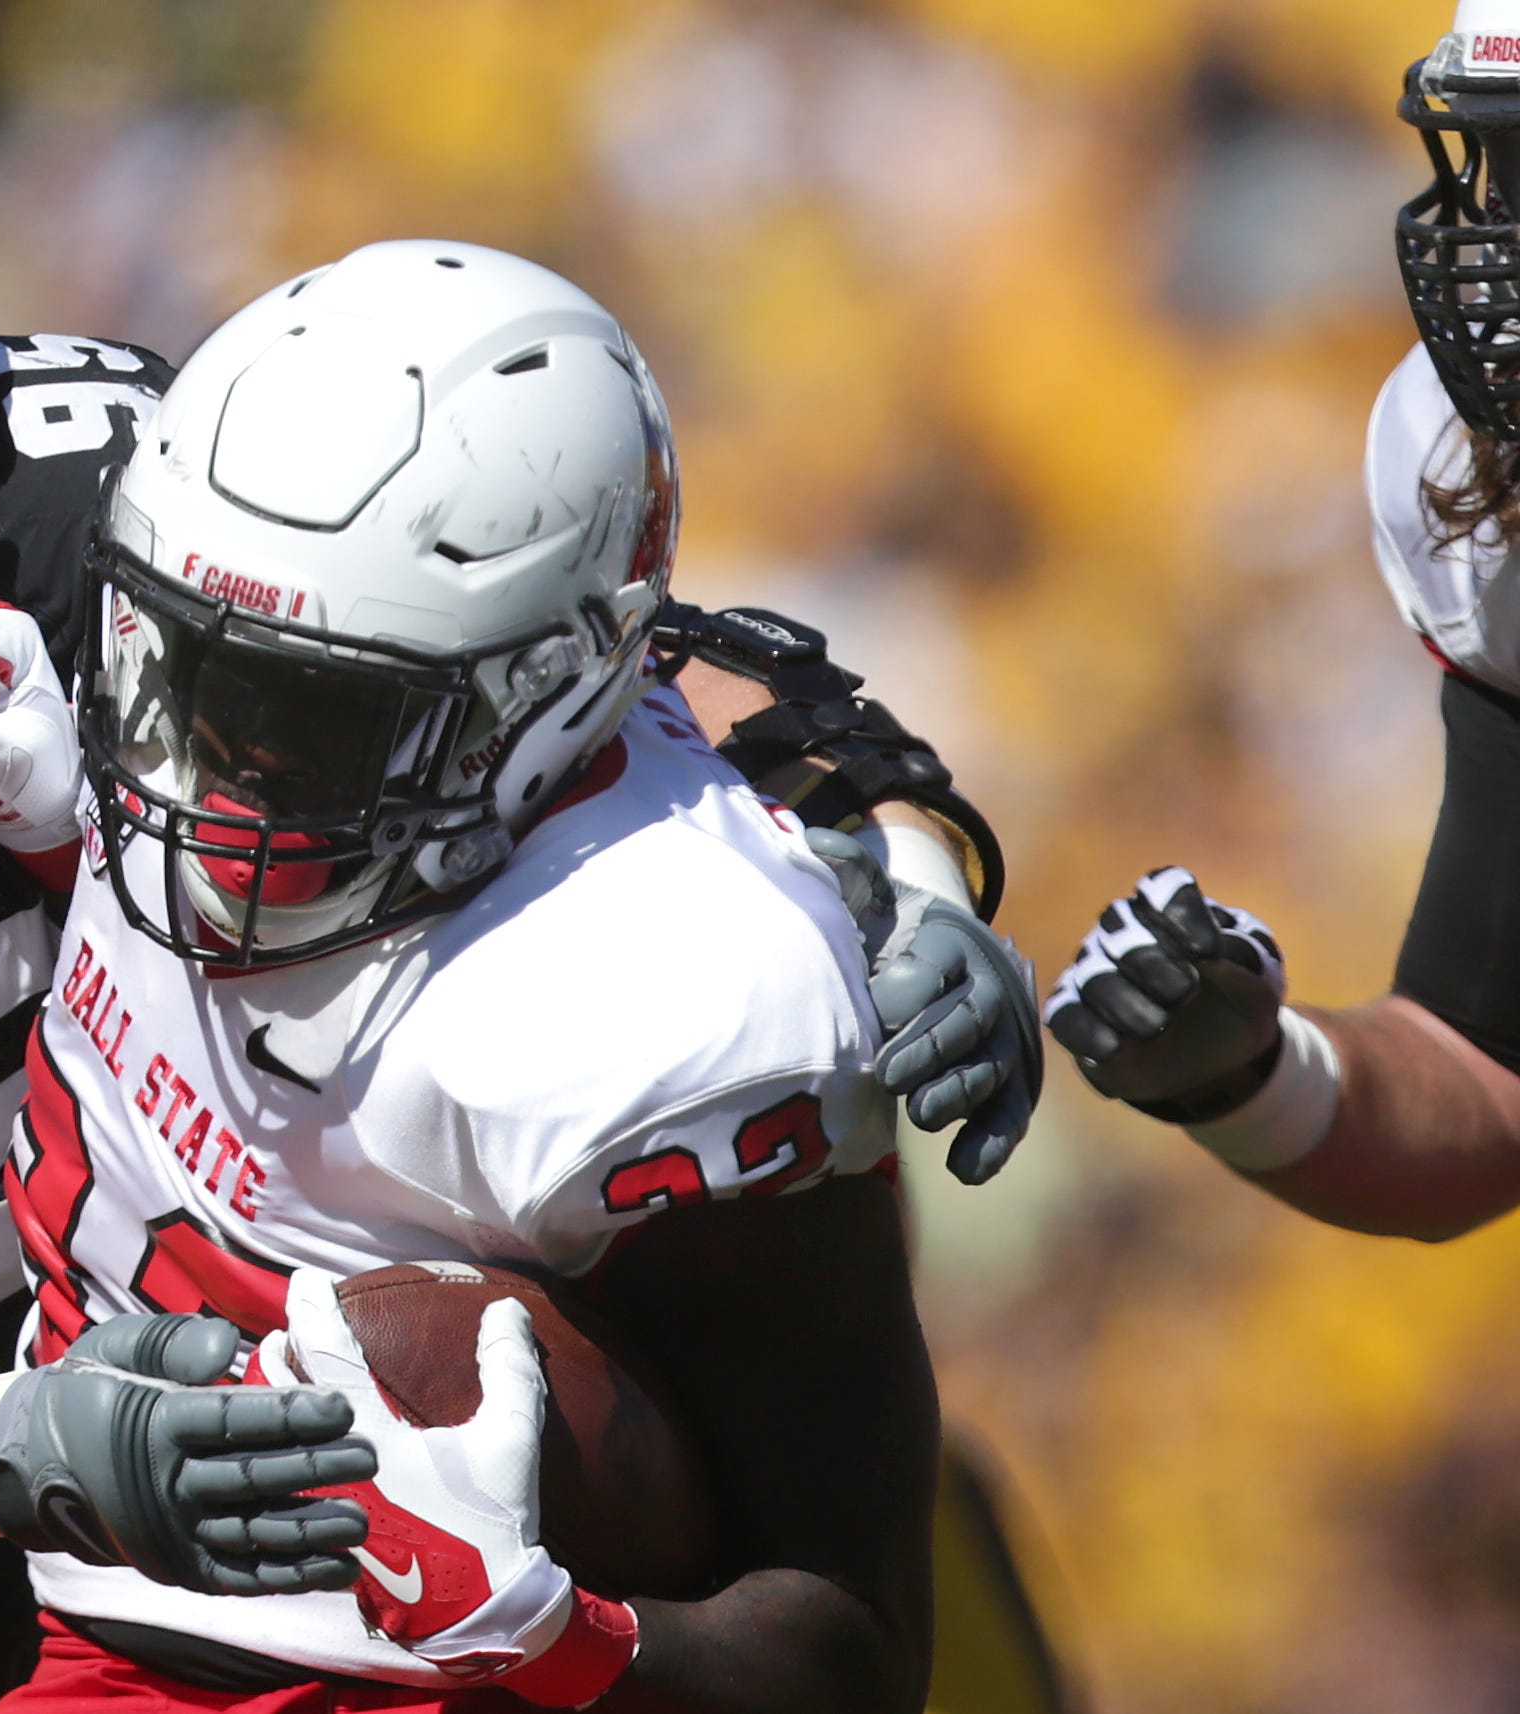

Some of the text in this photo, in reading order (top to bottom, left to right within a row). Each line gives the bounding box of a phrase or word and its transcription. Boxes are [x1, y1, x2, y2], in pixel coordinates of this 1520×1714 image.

[201, 565, 282, 616] CARDS
[63, 937, 132, 1079] BALL
[134, 1052, 267, 1222] STATE
